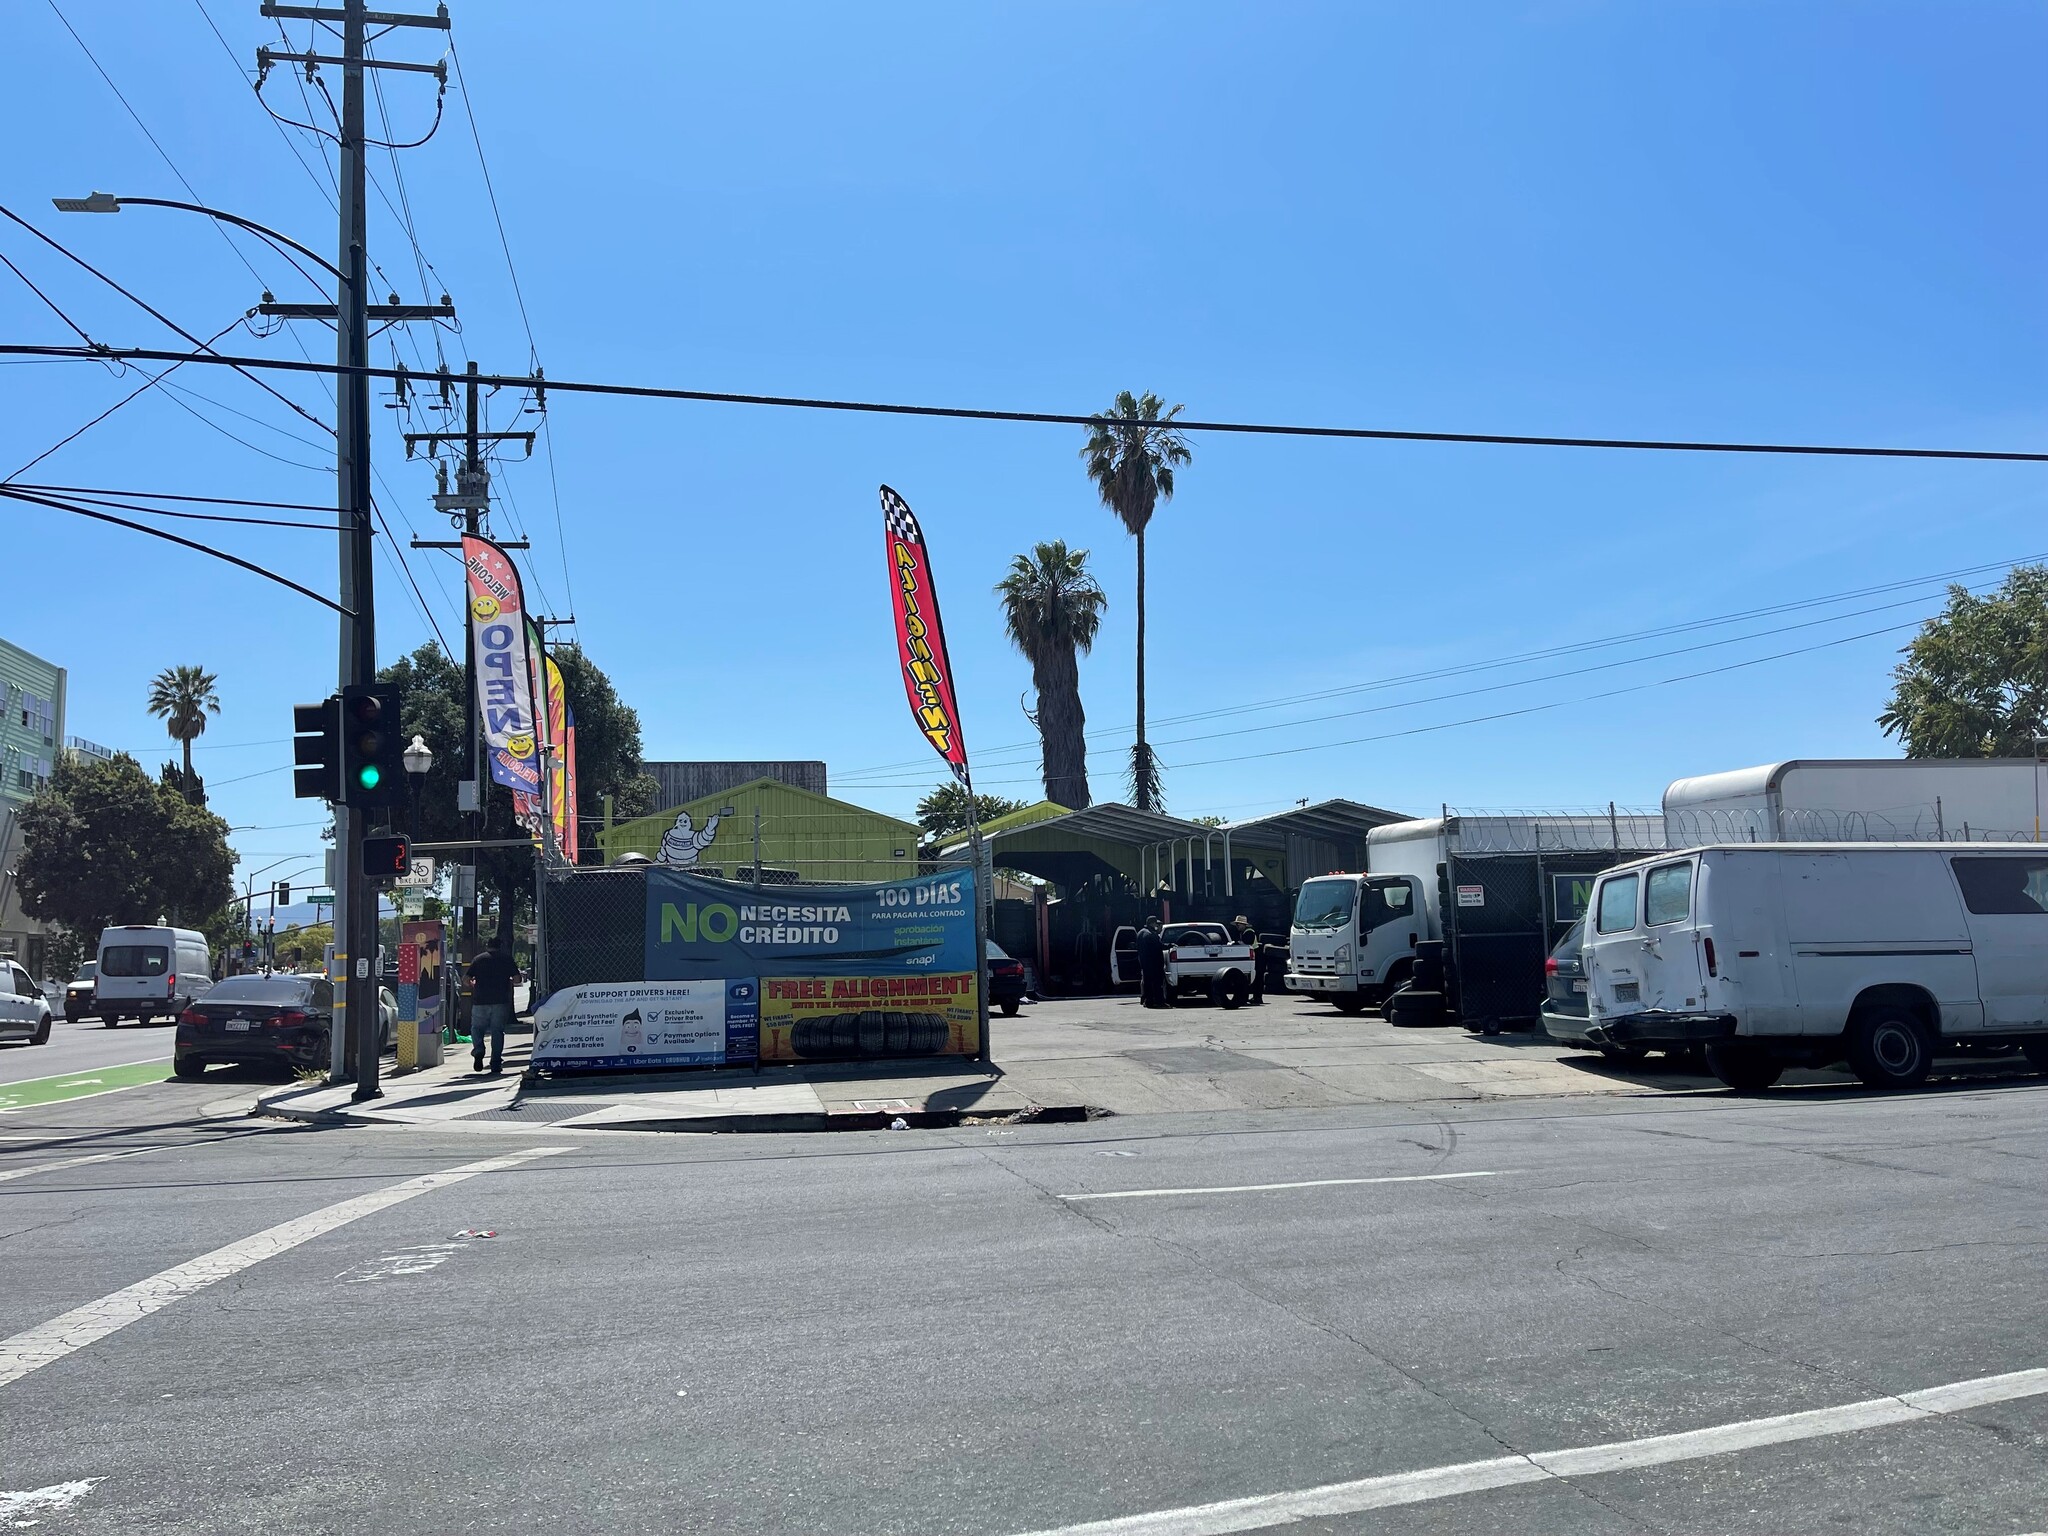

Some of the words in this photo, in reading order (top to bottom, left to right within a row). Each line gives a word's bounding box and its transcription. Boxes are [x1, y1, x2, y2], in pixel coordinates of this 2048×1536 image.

[395, 844, 406, 870] 2
[875, 887, 911, 907] 100
[915, 880, 962, 906] DÍAS
[740, 905, 852, 923] NECESITA
[871, 912, 892, 920] PARA
[892, 911, 918, 919] PAGAR
[929, 909, 966, 918] CONTADO
[660, 902, 739, 943] NO
[739, 923, 840, 945] CRÉDITO
[894, 923, 945, 936] aprobación
[906, 954, 936, 966] snap!
[735, 986, 749, 996] rs
[768, 980, 827, 999] FREE
[831, 974, 973, 999] ALIGNMENT
[576, 991, 588, 999] WE
[589, 990, 629, 999] SUPPORT
[630, 988, 665, 997] DRIVERS
[666, 988, 690, 996] HERE!
[586, 1012, 618, 1020] Synthetic
[663, 1031, 693, 1039] Payment
[694, 1029, 720, 1038] Options
[566, 1060, 588, 1068] amazon
